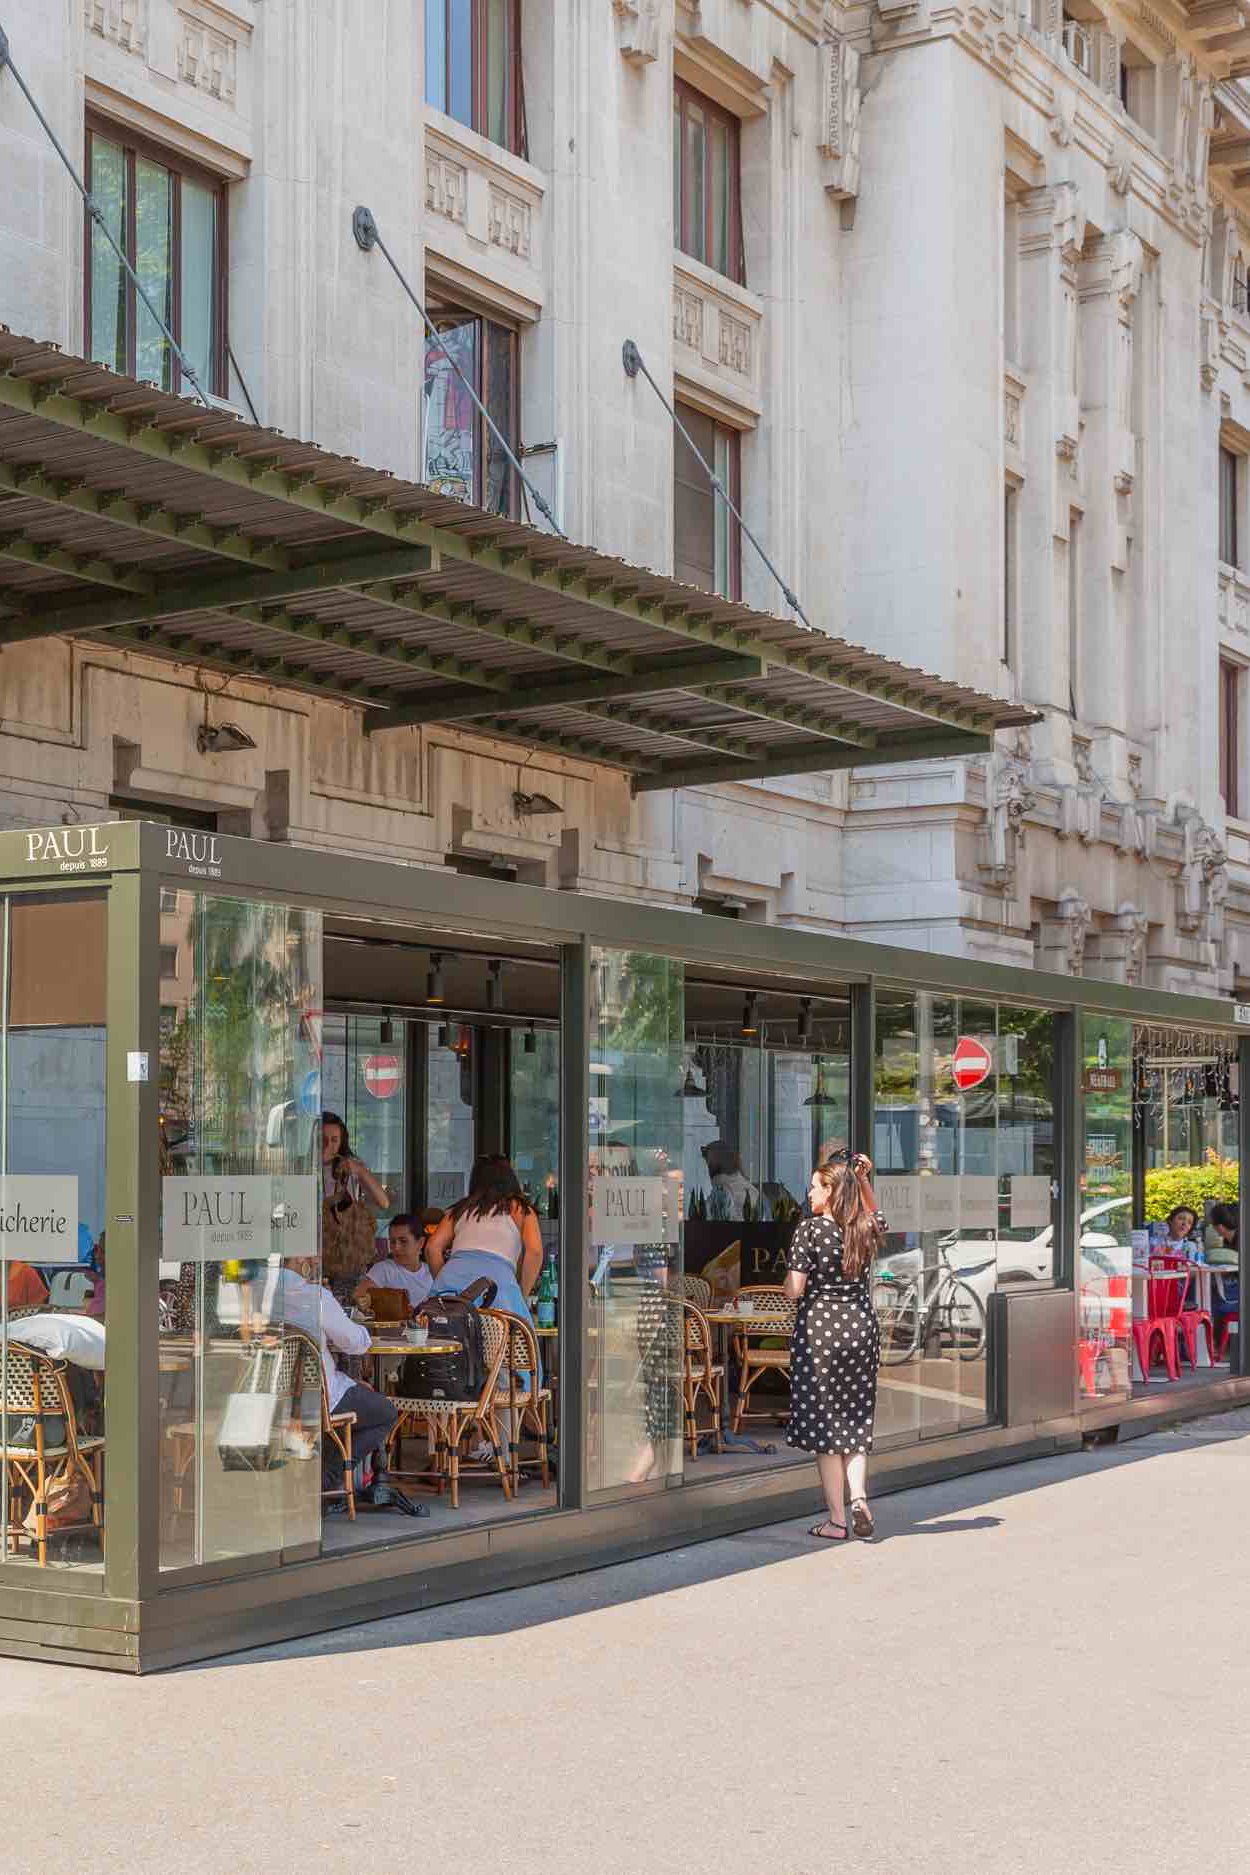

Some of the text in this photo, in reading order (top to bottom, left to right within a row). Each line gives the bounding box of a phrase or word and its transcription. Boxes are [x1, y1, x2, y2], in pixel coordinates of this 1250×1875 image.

[25, 827, 110, 862] PAUL
[165, 829, 223, 865] PAUL
[60, 856, 108, 872] depuis 1889
[188, 863, 207, 875] depuis
[182, 1190, 254, 1226] PAUL
[606, 1188, 650, 1217] PAUL
